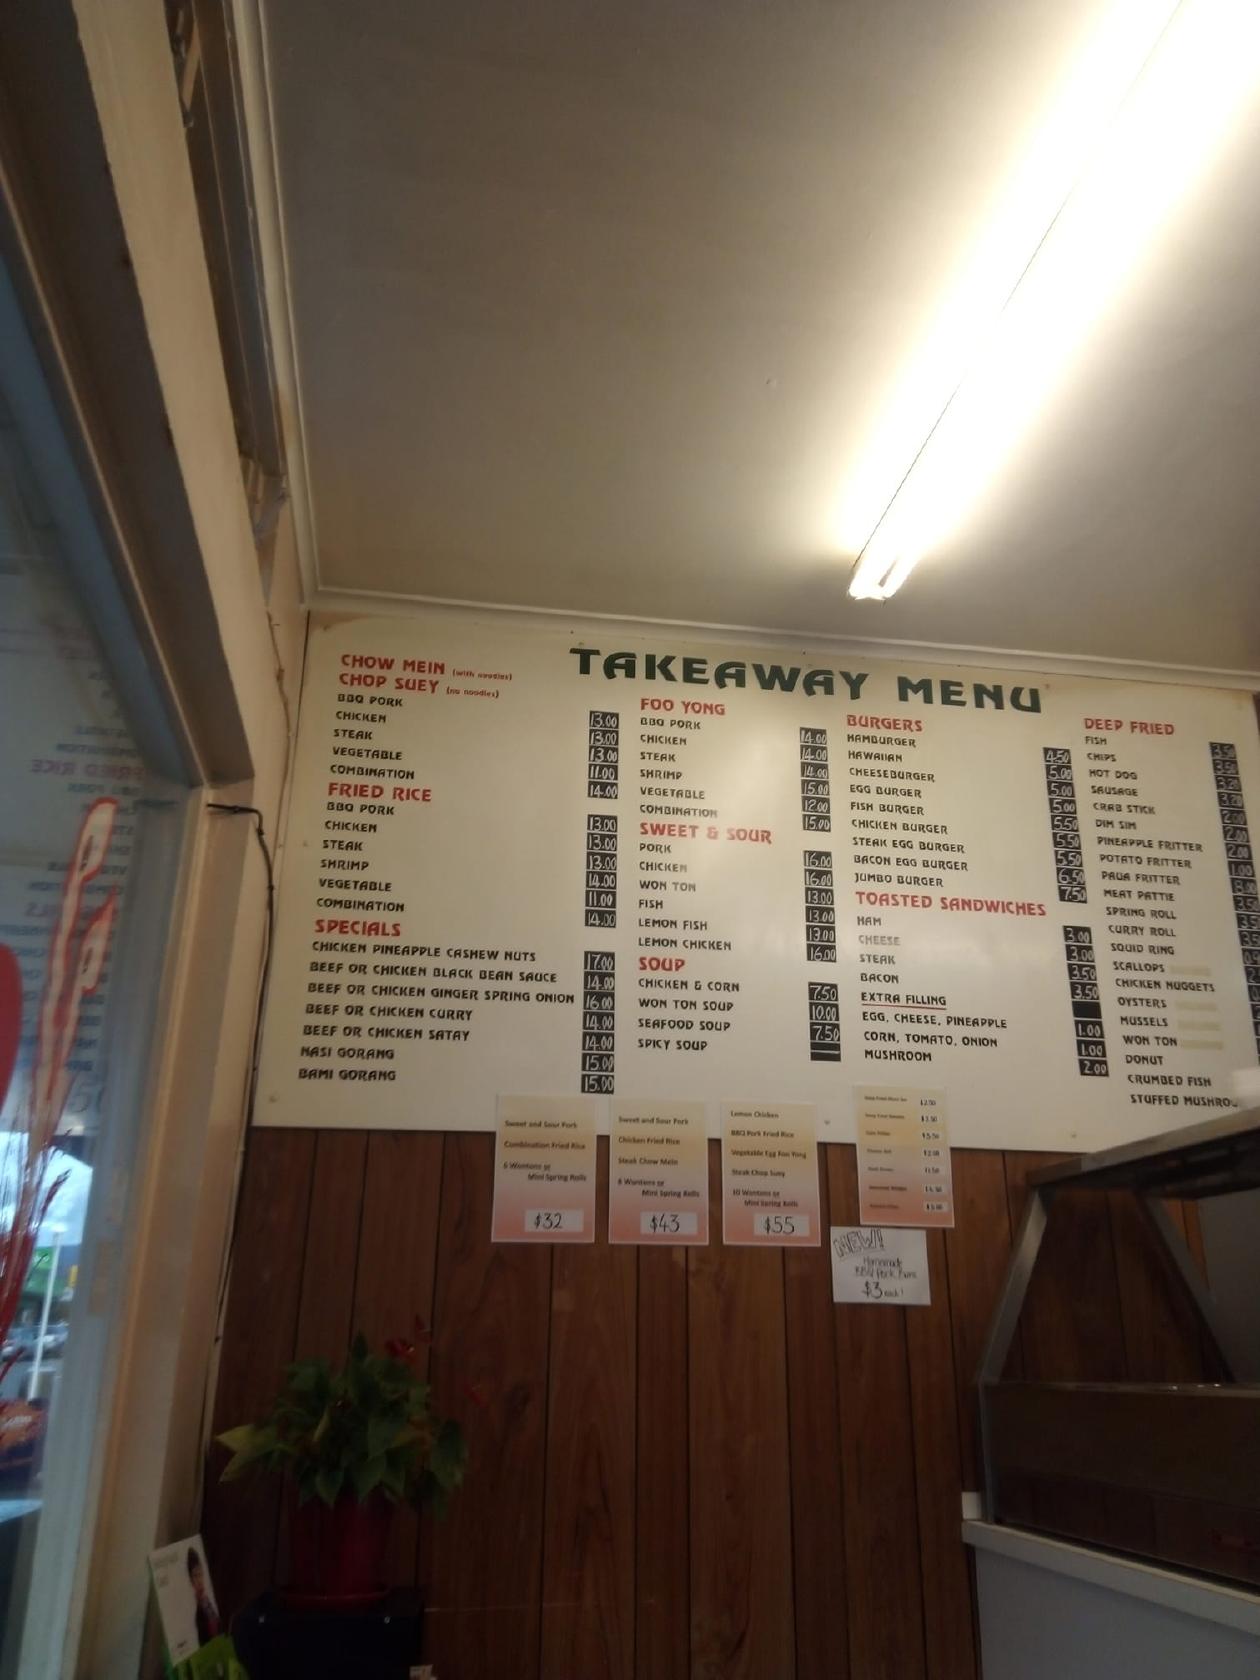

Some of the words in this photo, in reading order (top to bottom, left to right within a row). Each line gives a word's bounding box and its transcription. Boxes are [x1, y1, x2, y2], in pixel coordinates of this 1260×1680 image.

[341, 654, 394, 670] CHOW
[403, 659, 445, 675] MEIN
[452, 669, 475, 678] (with
[477, 672, 512, 681] noodles)
[339, 673, 386, 688] CHOP
[396, 677, 439, 693] SUEY
[446, 687, 460, 695] (no
[463, 688, 499, 698] noodles)
[569, 648, 869, 700] TAKEAWAY
[897, 676, 1041, 713] MENU
[338, 694, 364, 704] BBQ
[370, 696, 403, 707] PORK
[640, 698, 674, 712] FOO
[682, 701, 725, 715] YONG
[336, 711, 386, 723] CHICKEN
[590, 713, 617, 728] 13.00
[847, 715, 923, 732] BURGERS
[1085, 718, 1123, 730] DEEP
[1131, 721, 1174, 735] FRIED
[333, 729, 372, 740] STEAK
[848, 734, 916, 748] HAMBURGER
[333, 747, 402, 760] VEGETABLE
[1087, 753, 1116, 762] CHIPS
[330, 764, 415, 780] COMBINATION
[589, 766, 615, 780] 11.00
[640, 769, 682, 780] SHRIMP
[850, 768, 935, 782] CHEESEBURGER
[1090, 769, 1111, 778] HOT
[1115, 770, 1137, 780] DOG
[328, 782, 384, 798] FRIED
[392, 787, 432, 801] RICE
[804, 782, 829, 795] 15.00
[1050, 783, 1072, 796] 5.00
[1091, 786, 1138, 796] SAUSAGE
[804, 800, 828, 812] 12.00
[851, 802, 873, 811] FISH
[879, 804, 924, 815] BURGER
[1094, 802, 1122, 812] CRAB
[1127, 805, 1155, 814] STICK
[1096, 820, 1114, 829] DIM
[1119, 821, 1136, 830] SIM
[640, 823, 698, 838] SWEET
[707, 827, 718, 840] &
[727, 828, 772, 844] SOUR
[1097, 836, 1153, 848] PINEAPPLE
[1159, 841, 1203, 852] FRITTER
[321, 859, 369, 870] SHRIMP
[854, 855, 891, 866] BACON
[896, 858, 917, 867] EGG
[922, 859, 968, 871] BURGER
[855, 873, 892, 883] JUMBO
[897, 876, 944, 887] BURGER
[1136, 874, 1180, 885] FRITTER
[1104, 889, 1132, 899] MEAT
[1138, 891, 1174, 901] PATTIE
[317, 898, 404, 912] COMBINATION
[639, 900, 663, 910] FISH
[856, 891, 932, 908] TOASTED
[941, 897, 1046, 916] SANDWICHES
[1106, 907, 1145, 917] SPRING
[1151, 910, 1176, 919] ROLL
[857, 916, 881, 926] HAM
[315, 919, 400, 937] SPECIALS
[1109, 925, 1144, 935] CURRY
[1150, 927, 1176, 937] ROLL
[1067, 928, 1090, 943] 3.00
[639, 938, 677, 948] LEMON
[683, 940, 731, 951] CHICKEN
[1111, 943, 1144, 953] SQUID
[1149, 945, 1174, 955] RING
[313, 941, 366, 953] CHICKEN
[373, 944, 441, 957] PINEAPPLE
[447, 948, 499, 960] CASHEW
[504, 951, 536, 962] NUTS
[810, 946, 836, 961] 16.00
[587, 953, 613, 969] 17.00
[640, 957, 685, 971] SOUP
[1113, 961, 1165, 972] SCALLOPS
[310, 962, 343, 973] BEEF
[349, 964, 367, 975] OR
[373, 965, 427, 977] CHICKEN
[433, 968, 473, 979] BLACK
[480, 969, 513, 981] BEAN
[519, 972, 557, 982] SAUCE
[861, 973, 899, 984] BACON
[639, 978, 688, 990] CHICKEN
[695, 980, 701, 990] &
[708, 981, 739, 992] CORN
[308, 983, 341, 994] BEEF
[347, 984, 365, 995] OR
[372, 985, 425, 998] CHICKEN
[431, 988, 478, 1000] GINGER
[485, 991, 529, 1002] SPRING
[536, 993, 574, 1004] ONION
[811, 985, 836, 1001] 7.50
[862, 992, 900, 1003] EXTRA
[906, 995, 946, 1005] FILLING
[586, 994, 612, 1009] 16.00
[639, 998, 667, 1008] WON
[673, 1000, 696, 1010] TON
[703, 1001, 733, 1011] SOUP
[1118, 997, 1167, 1008] OYSTERS
[306, 1004, 339, 1015] BEEF
[345, 1005, 364, 1016] OR
[369, 1006, 424, 1018] CHICKEN
[430, 1009, 472, 1021] CURRY
[812, 1006, 836, 1020] 10.00
[638, 1018, 693, 1030] SEAFOOD
[700, 1021, 730, 1031] SOUP
[946, 1016, 1007, 1028] PINEAPPLE
[1120, 1016, 1168, 1027] MUSSELS
[638, 1038, 670, 1049] SPICY
[676, 1040, 707, 1050] SOUP
[962, 1037, 997, 1047] ONION
[301, 1047, 331, 1058] NASI
[338, 1048, 394, 1060] GORANG
[865, 1050, 932, 1061] MUSHROOM
[1126, 1055, 1163, 1065] DONUT
[1084, 1060, 1107, 1074] 2.00
[299, 1068, 333, 1079] BAMI
[339, 1070, 396, 1081] GORANG
[1128, 1074, 1183, 1086] CRUMBED
[1188, 1077, 1211, 1086] FISH
[585, 1077, 614, 1092] 15.00
[1131, 1094, 1179, 1105] STUFFED
[534, 1212, 563, 1230] $32
[650, 1214, 679, 1233] $43
[763, 1215, 794, 1235] $55
[833, 1228, 885, 1259] NEW!
[864, 1280, 883, 1299] $3
